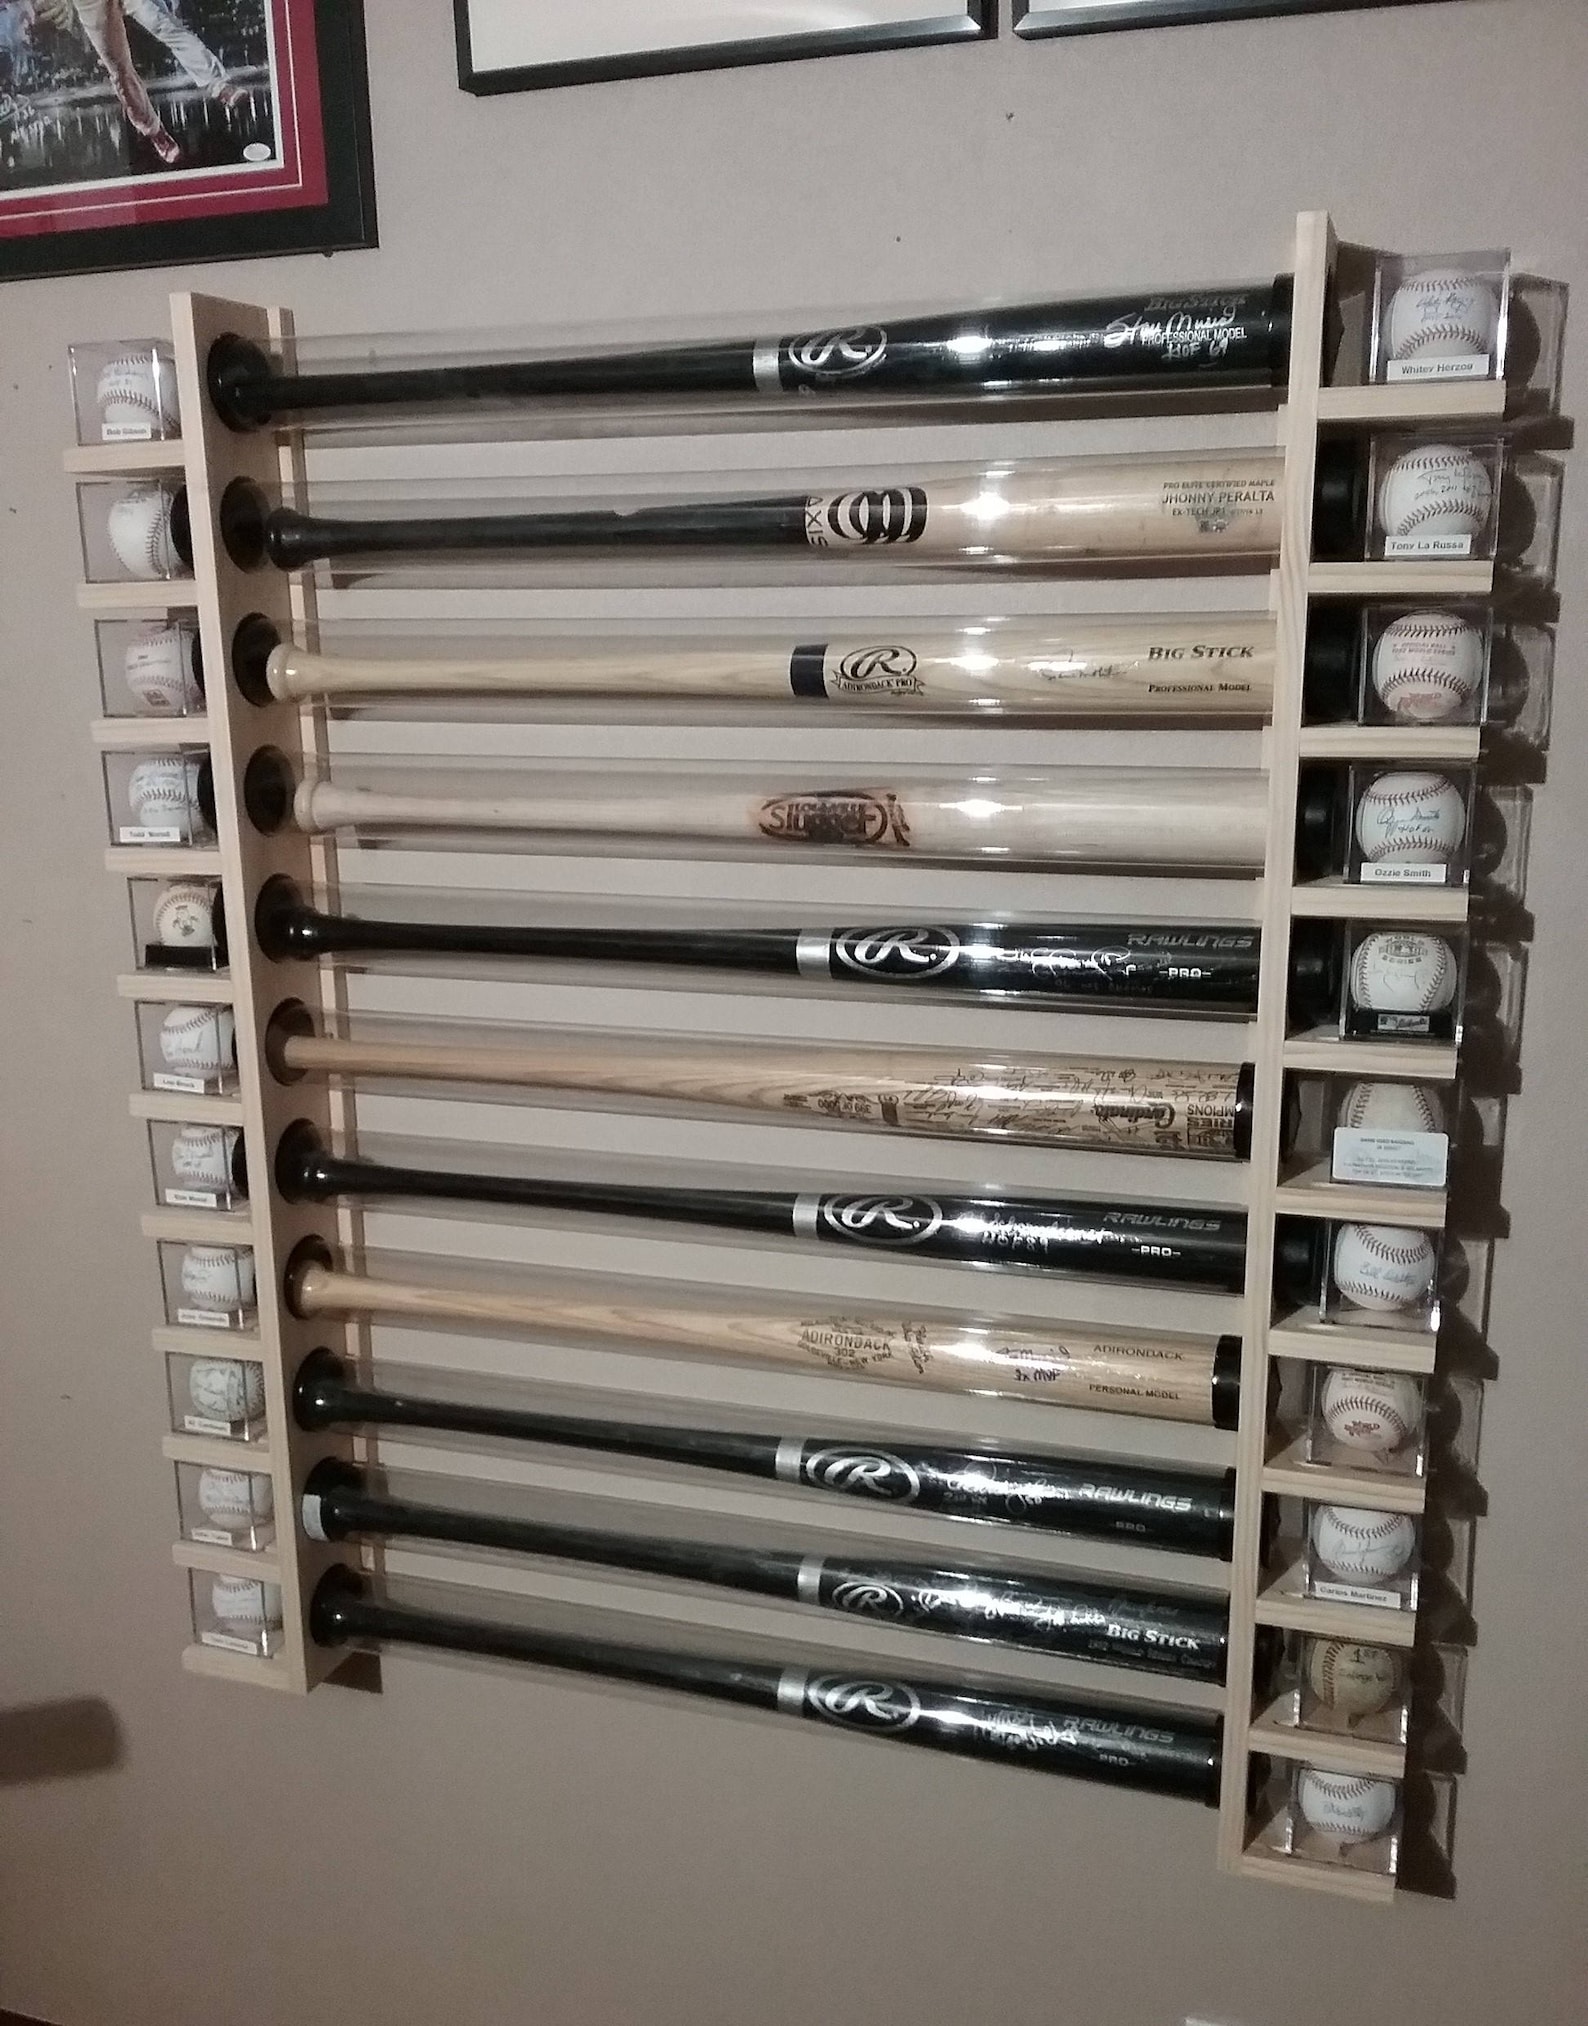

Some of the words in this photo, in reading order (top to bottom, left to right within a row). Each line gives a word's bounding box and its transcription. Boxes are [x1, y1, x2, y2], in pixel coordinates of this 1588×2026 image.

[1214, 326, 1247, 340] MODEL
[1162, 491, 1215, 504] JHONNY
[1218, 490, 1275, 503] PERALTA
[1417, 540, 1431, 549] La
[1433, 540, 1464, 550] Russa
[1403, 869, 1432, 877] Smith
[1127, 933, 1254, 948] RAWLINGS
[1103, 1211, 1222, 1231] RAWLINGS
[1093, 1344, 1184, 1361] ADIRONDACK
[1089, 1384, 1143, 1397] PERSONAL
[1145, 1388, 1181, 1400] MODEL
[1079, 1482, 1193, 1511] RAWLINGS
[1063, 1715, 1175, 1744] RAWLINGS
